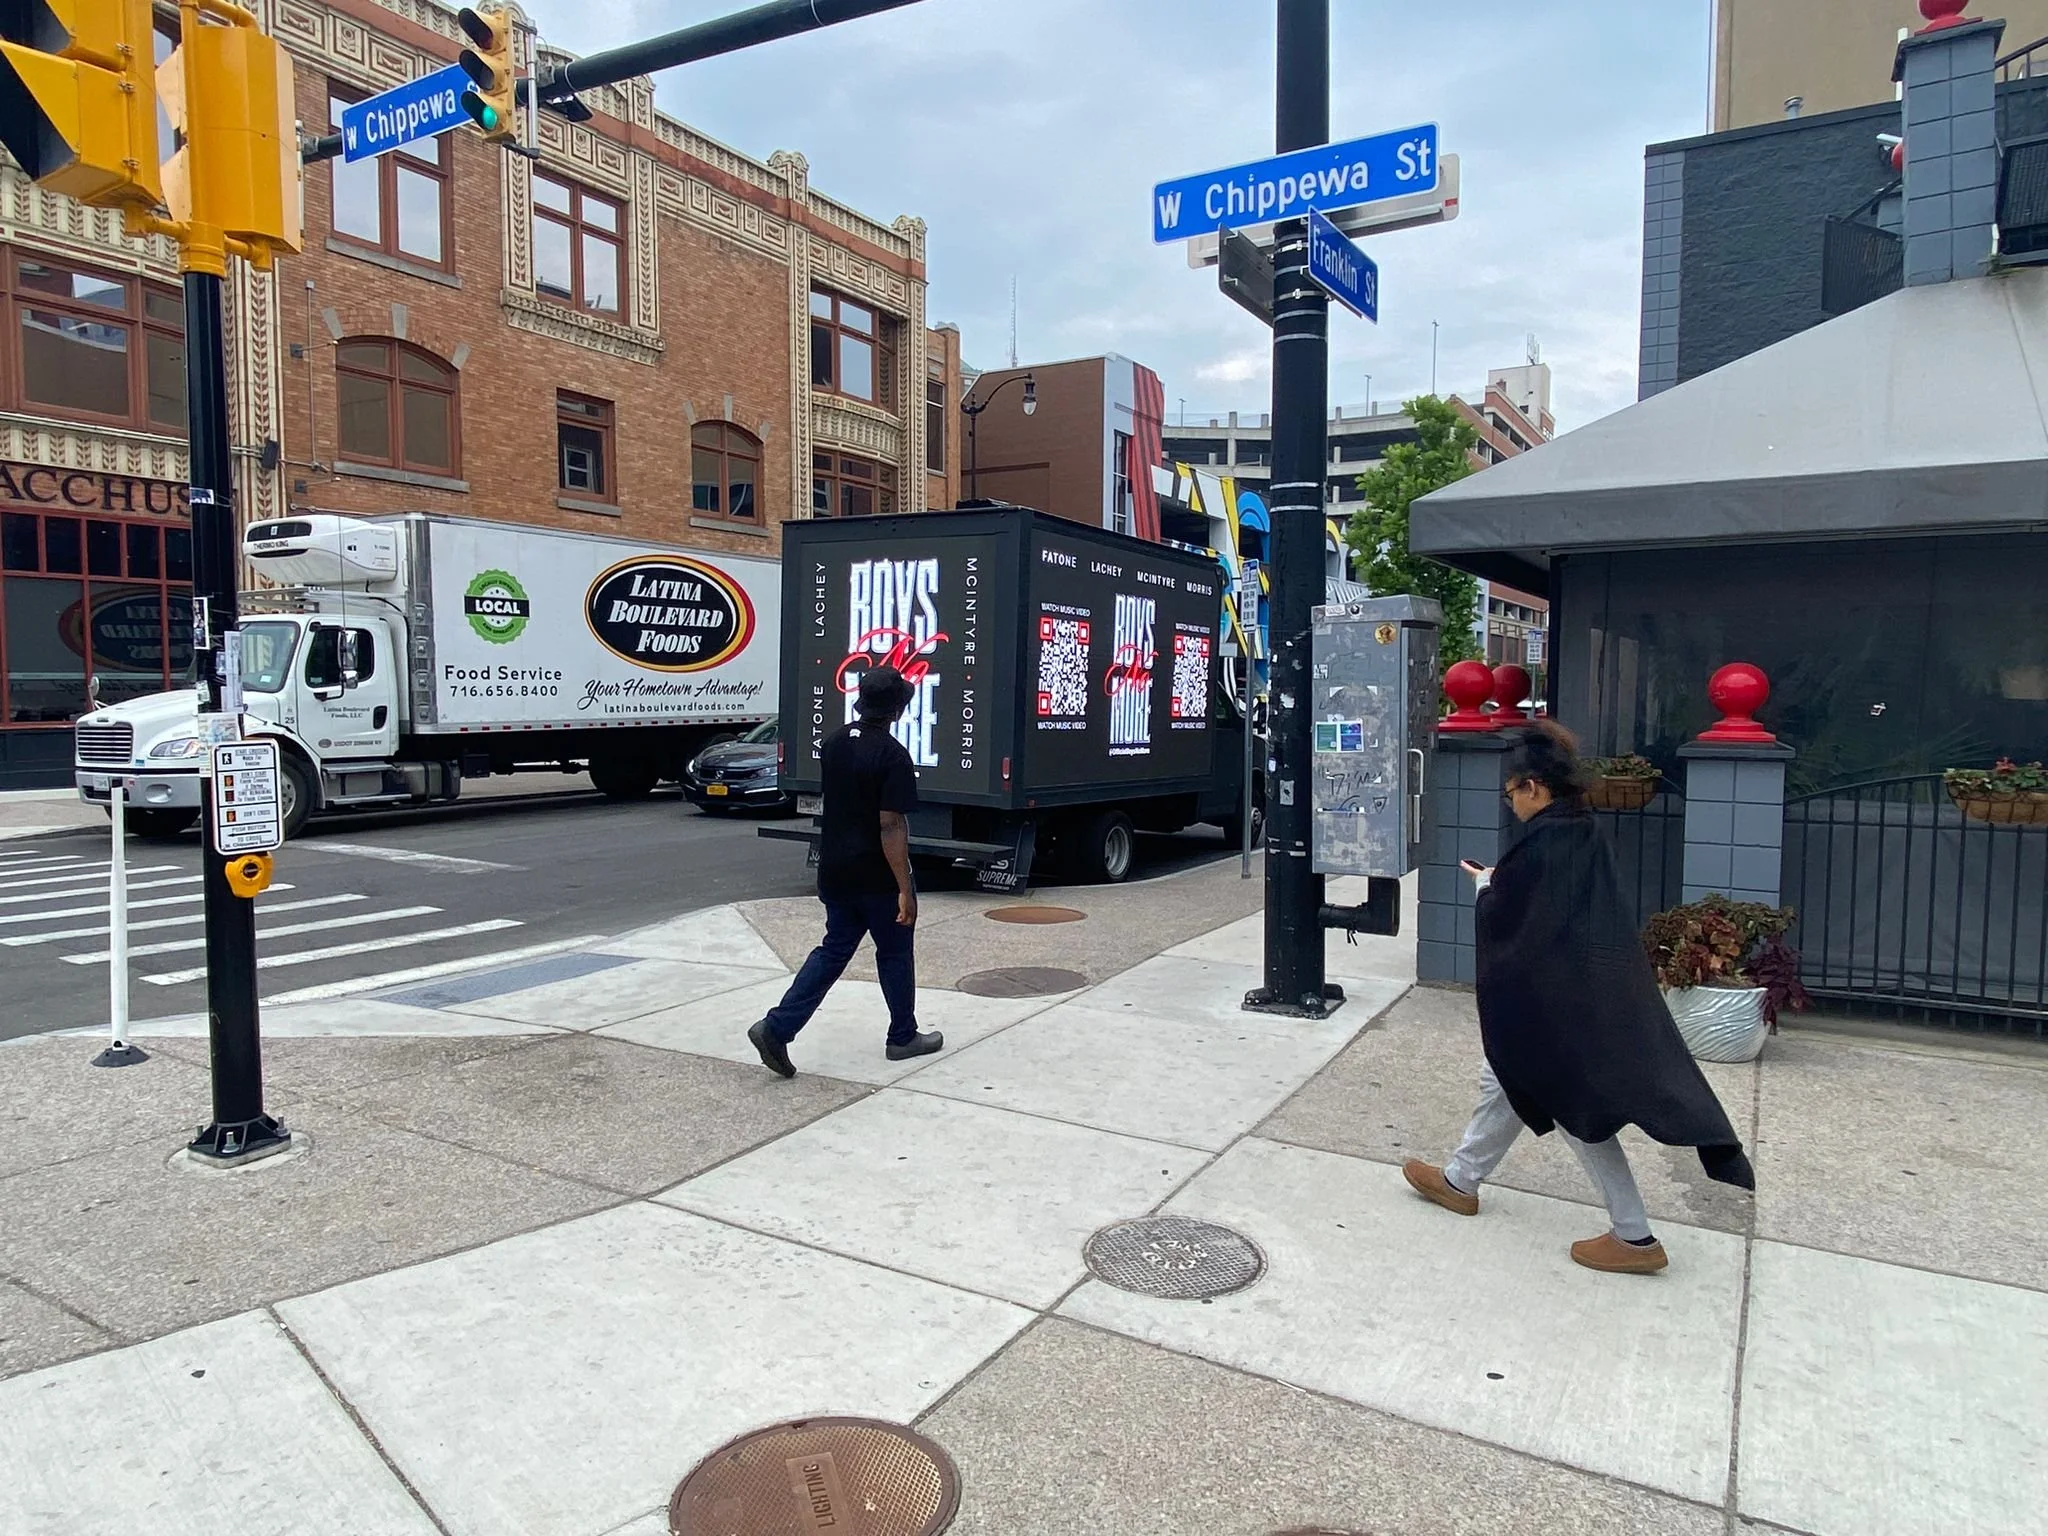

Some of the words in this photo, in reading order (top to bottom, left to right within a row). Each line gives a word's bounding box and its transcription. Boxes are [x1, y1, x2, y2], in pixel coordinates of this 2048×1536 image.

[365, 88, 457, 144] Chippewa
[1158, 191, 1183, 229] W
[1204, 160, 1370, 219] Chippewa
[1395, 138, 1431, 182] St
[1312, 224, 1359, 294] Franklin
[1365, 270, 1377, 307] St
[253, 540, 275, 550] THERMO
[275, 539, 289, 548] KING
[629, 574, 703, 602] LATINA
[1042, 549, 1078, 569] FATONE
[1091, 561, 1123, 578] LACHEY
[1136, 571, 1176, 589] MCINTYRE
[1186, 581, 1213, 597] MORRIS
[475, 599, 521, 615] LOCAL
[607, 600, 724, 628] BOULEVARD
[814, 561, 827, 637] LACHEY
[848, 558, 939, 655] BOYS
[962, 557, 978, 666] MCINTYRE
[1041, 602, 1060, 613] WATCH
[1059, 604, 1077, 616] MUSIC
[1075, 606, 1092, 618] VIDEO
[635, 629, 702, 654] FOODS
[1113, 593, 1156, 670] BOYS
[444, 664, 491, 681] Food
[498, 665, 563, 682] Service
[450, 685, 559, 698] 716.656.8400
[577, 679, 622, 711] Your
[622, 678, 693, 699] Hometown
[694, 679, 764, 701] Advantage!
[604, 702, 745, 714] latinaboulevardfoods.com
[284, 716, 295, 724] 25
[811, 685, 825, 760] FATONE
[1037, 721, 1056, 731] WATCH
[1056, 721, 1072, 731] MUSIC
[1071, 722, 1087, 731] VIDEO
[1109, 675, 1153, 745] MORE
[960, 689, 975, 770] MORRIS
[976, 870, 1018, 887] SUPREME
[802, 1462, 838, 1529] LIGHTING
